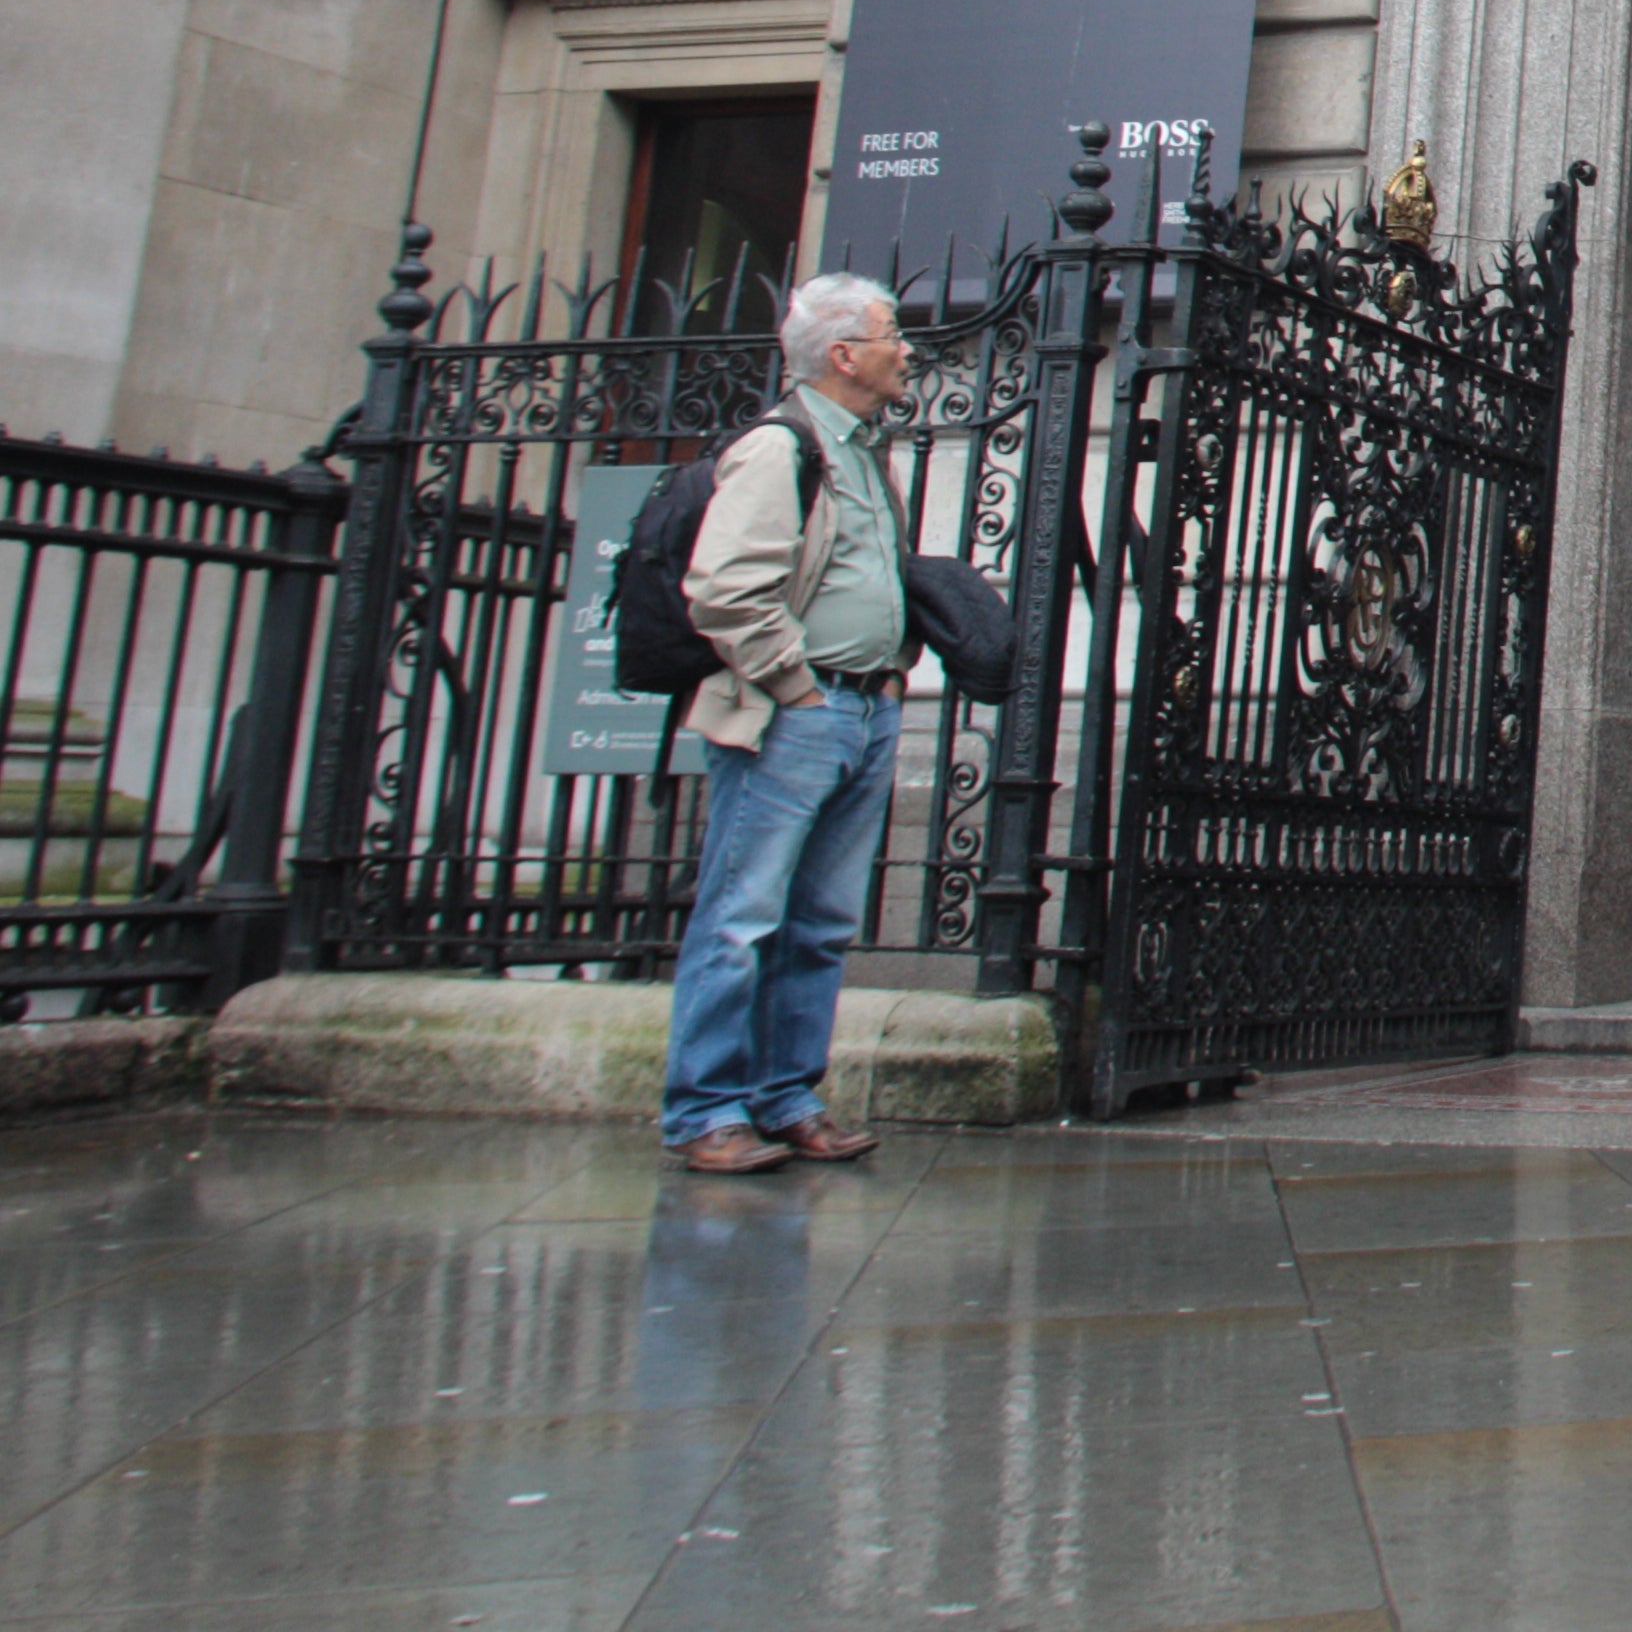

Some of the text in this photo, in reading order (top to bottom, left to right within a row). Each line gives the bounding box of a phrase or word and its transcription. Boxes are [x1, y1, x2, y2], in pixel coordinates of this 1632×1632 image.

[860, 130, 940, 153] FREE FOR
[857, 157, 940, 180] MEMBERS
